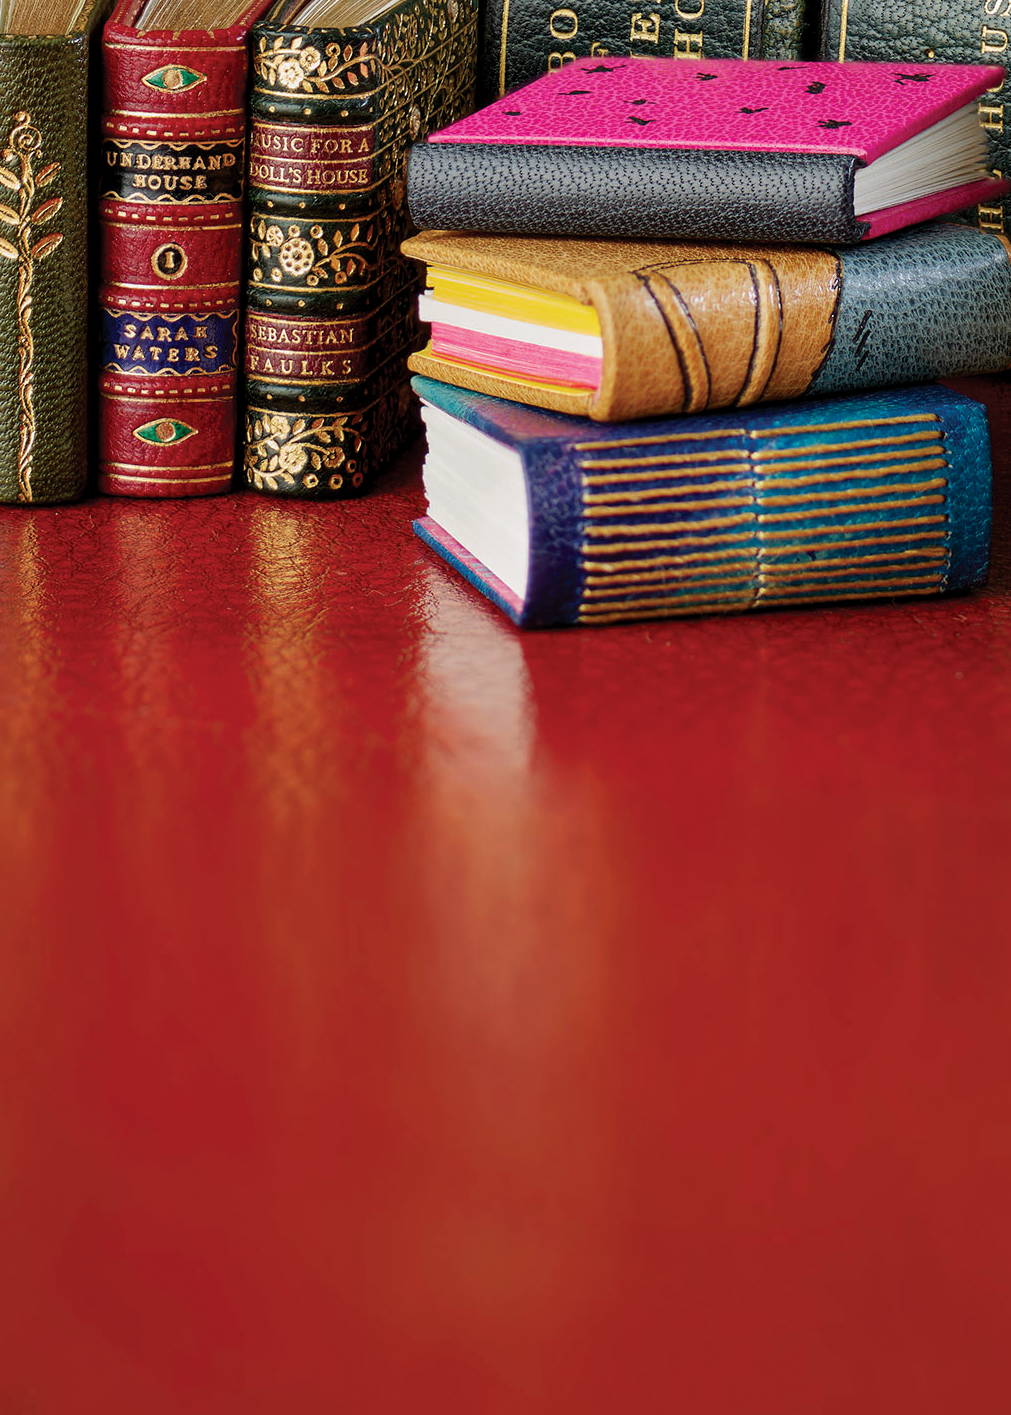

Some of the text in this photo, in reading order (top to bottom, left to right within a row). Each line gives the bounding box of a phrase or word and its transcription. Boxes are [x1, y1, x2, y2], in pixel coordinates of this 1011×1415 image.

[311, 138, 353, 154] FOR
[358, 138, 370, 152] A
[106, 150, 236, 170] UNDERHAND
[250, 161, 368, 184] DOLL'S HOUSE
[132, 174, 207, 191] HOUSE
[124, 324, 207, 342] SARAH
[251, 324, 354, 345] SEBASTIAN
[113, 343, 218, 362] WATERS
[250, 355, 352, 376] FAULKS
